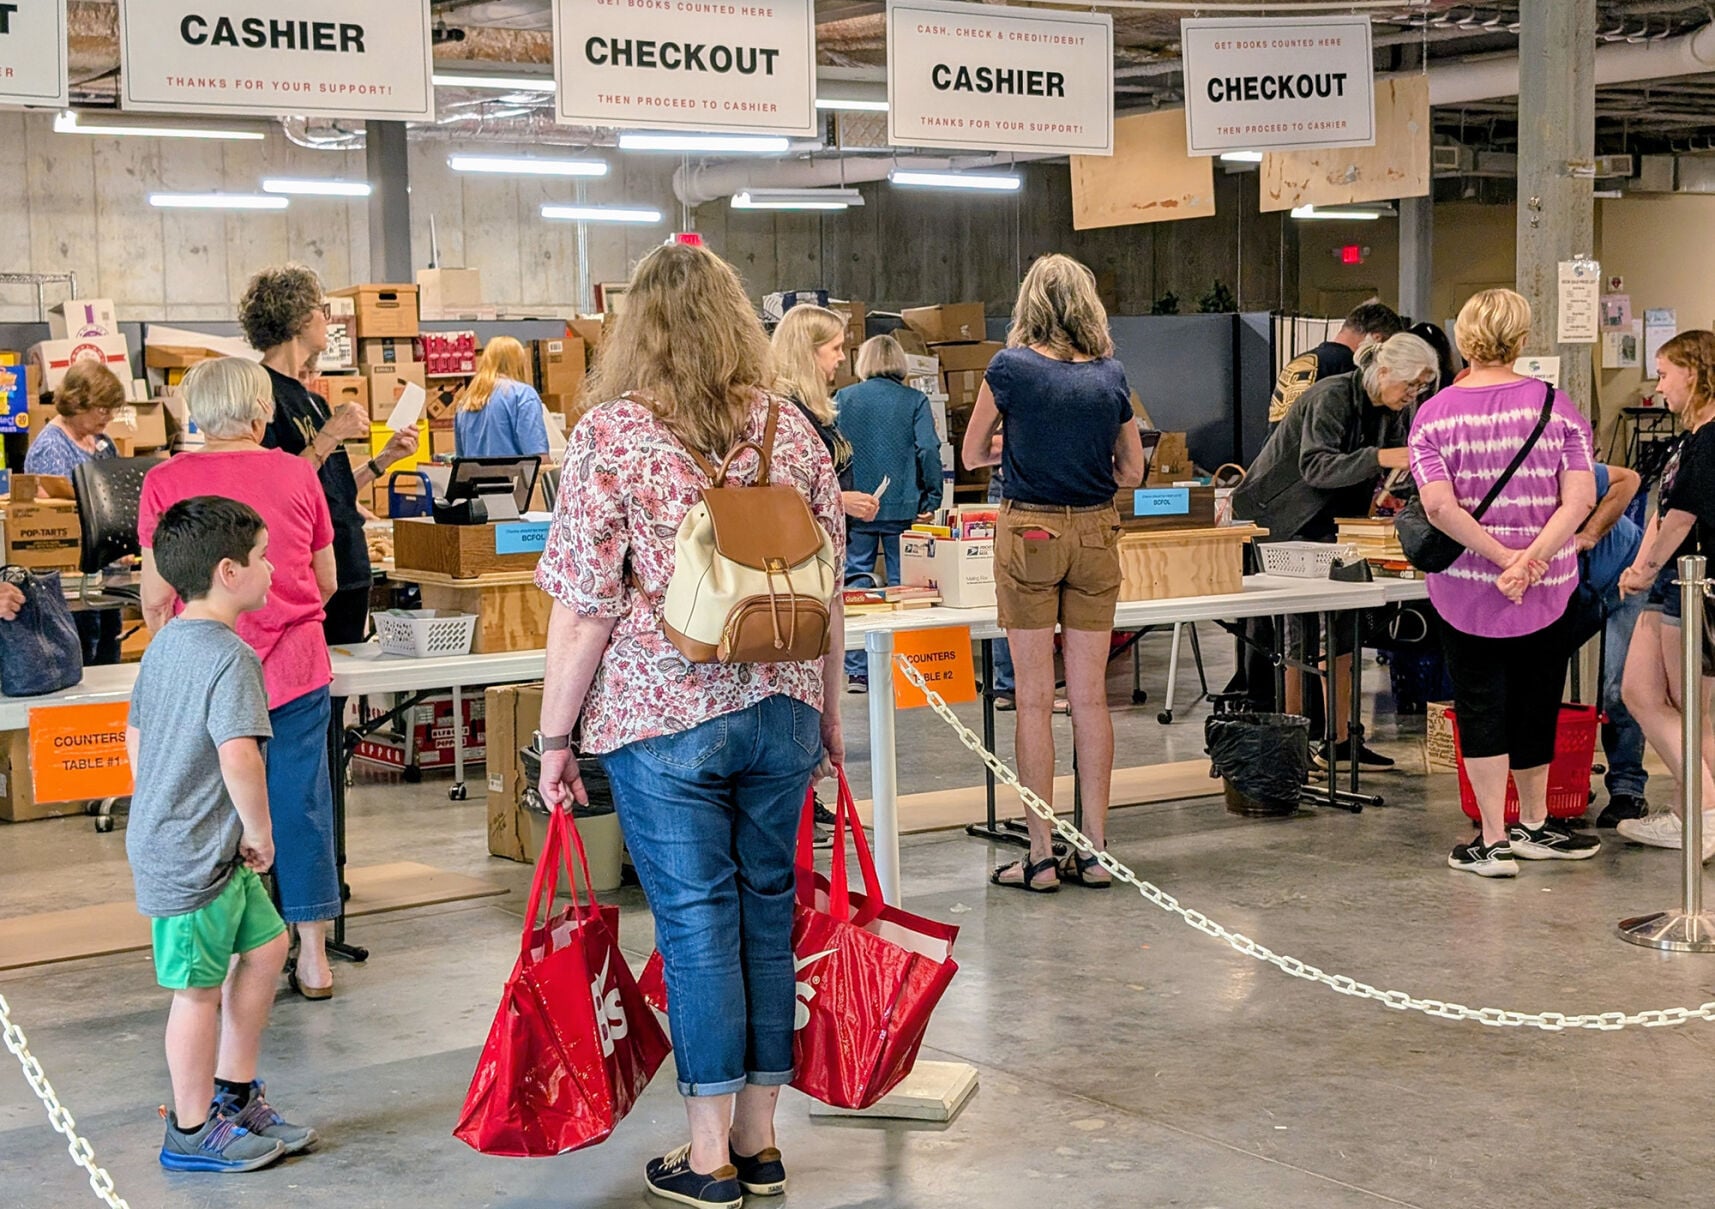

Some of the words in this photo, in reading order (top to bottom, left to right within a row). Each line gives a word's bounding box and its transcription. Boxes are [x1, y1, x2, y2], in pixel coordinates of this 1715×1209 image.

[628, 0, 671, 10] BOOKS
[677, 3, 737, 15] COUNTED
[741, 7, 774, 17] HERE
[180, 14, 366, 53] CASHIER
[955, 28, 993, 39] CHECK
[997, 32, 1004, 40] &
[1008, 31, 1086, 46] CREDIT/DEBIT
[1214, 41, 1233, 50] GET
[1236, 41, 1268, 49] BOOKS
[1271, 39, 1314, 48] COUNTED
[1318, 38, 1342, 47] HERE
[585, 36, 780, 76] CHECKOUT
[167, 76, 227, 89] THANKS
[235, 79, 264, 90] FOR
[272, 80, 312, 92] YOUR
[319, 82, 393, 95] SUPPORT!
[931, 63, 1066, 98] CASHIER
[1207, 73, 1347, 103] CHECKOUT
[597, 94, 631, 105] THEN
[637, 96, 696, 109] PROCEED
[702, 100, 718, 110] TO
[723, 101, 778, 113] CASHIER
[920, 116, 964, 128] THANKS
[969, 119, 991, 129] FOR
[995, 121, 1025, 131] YOUR
[1029, 123, 1083, 134] SUPPORT!
[1217, 126, 1242, 135] THEN
[1245, 124, 1288, 134] PROCEED
[1292, 122, 1303, 131] TO
[1307, 120, 1347, 130] CASHIER
[20, 527, 68, 538] POP-TARTS
[521, 533, 545, 541] BCFOL
[906, 650, 956, 664] COUNTERS
[913, 671, 941, 683] TBLE
[943, 671, 953, 680] #2
[53, 731, 126, 748] COUNTERS
[62, 757, 104, 771] TABLE
[107, 756, 120, 767] #1
